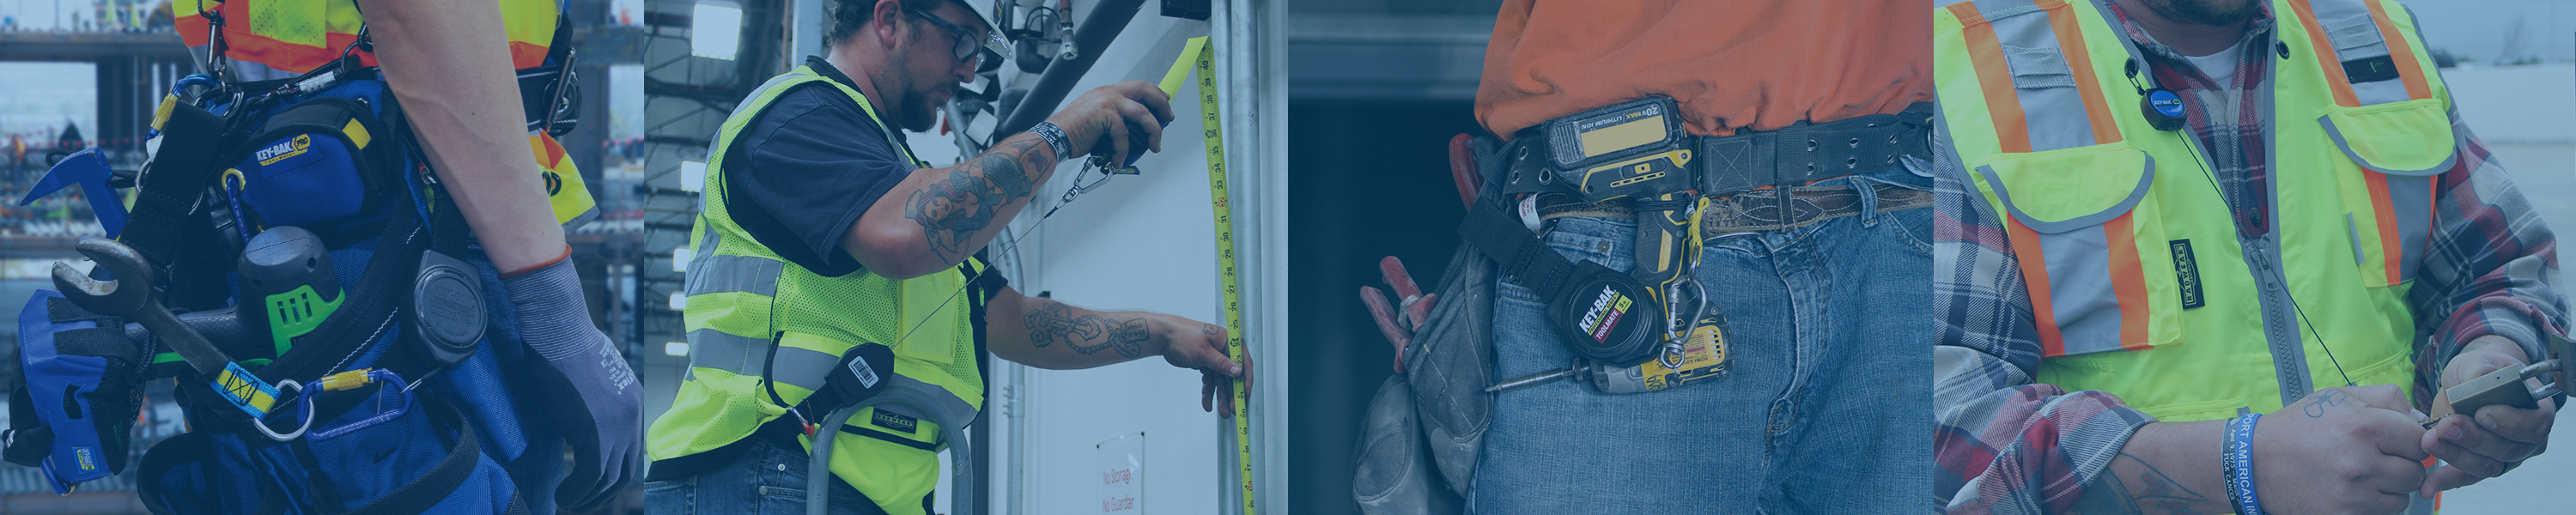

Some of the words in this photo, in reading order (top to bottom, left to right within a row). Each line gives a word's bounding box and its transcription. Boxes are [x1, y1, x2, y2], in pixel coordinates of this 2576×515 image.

[1202, 60, 1209, 70] 40
[1205, 77, 1212, 87] 39
[1206, 94, 1213, 104] 38
[1208, 112, 1215, 121] 37
[1595, 116, 1622, 126] LITHIUM
[1211, 129, 1217, 137] 36
[296, 136, 309, 147] PRO
[1212, 146, 1219, 155] 35
[1214, 163, 1221, 173] 34
[1217, 180, 1223, 190] 33
[1223, 232, 1229, 241] 30
[1224, 249, 1231, 259] 29
[1227, 267, 1233, 276] 28
[2178, 249, 2193, 301] RADWEAR
[1229, 285, 1235, 294] 27
[1230, 301, 1236, 312] 26
[1589, 309, 1607, 334] PROFESSIONAL
[1607, 296, 1617, 309] SERIES
[1233, 319, 1238, 329] 25
[1595, 310, 1619, 340] TOOLMATE
[1237, 354, 1242, 365] 23
[1242, 409, 1246, 418] 20
[1103, 470, 1110, 485] No
[2239, 440, 2253, 503] AMERICAN
[2246, 506, 2258, 515] IN
[2226, 474, 2235, 501] CANCER
[1103, 498, 1110, 512] No
[1111, 494, 1134, 512] Guardar
